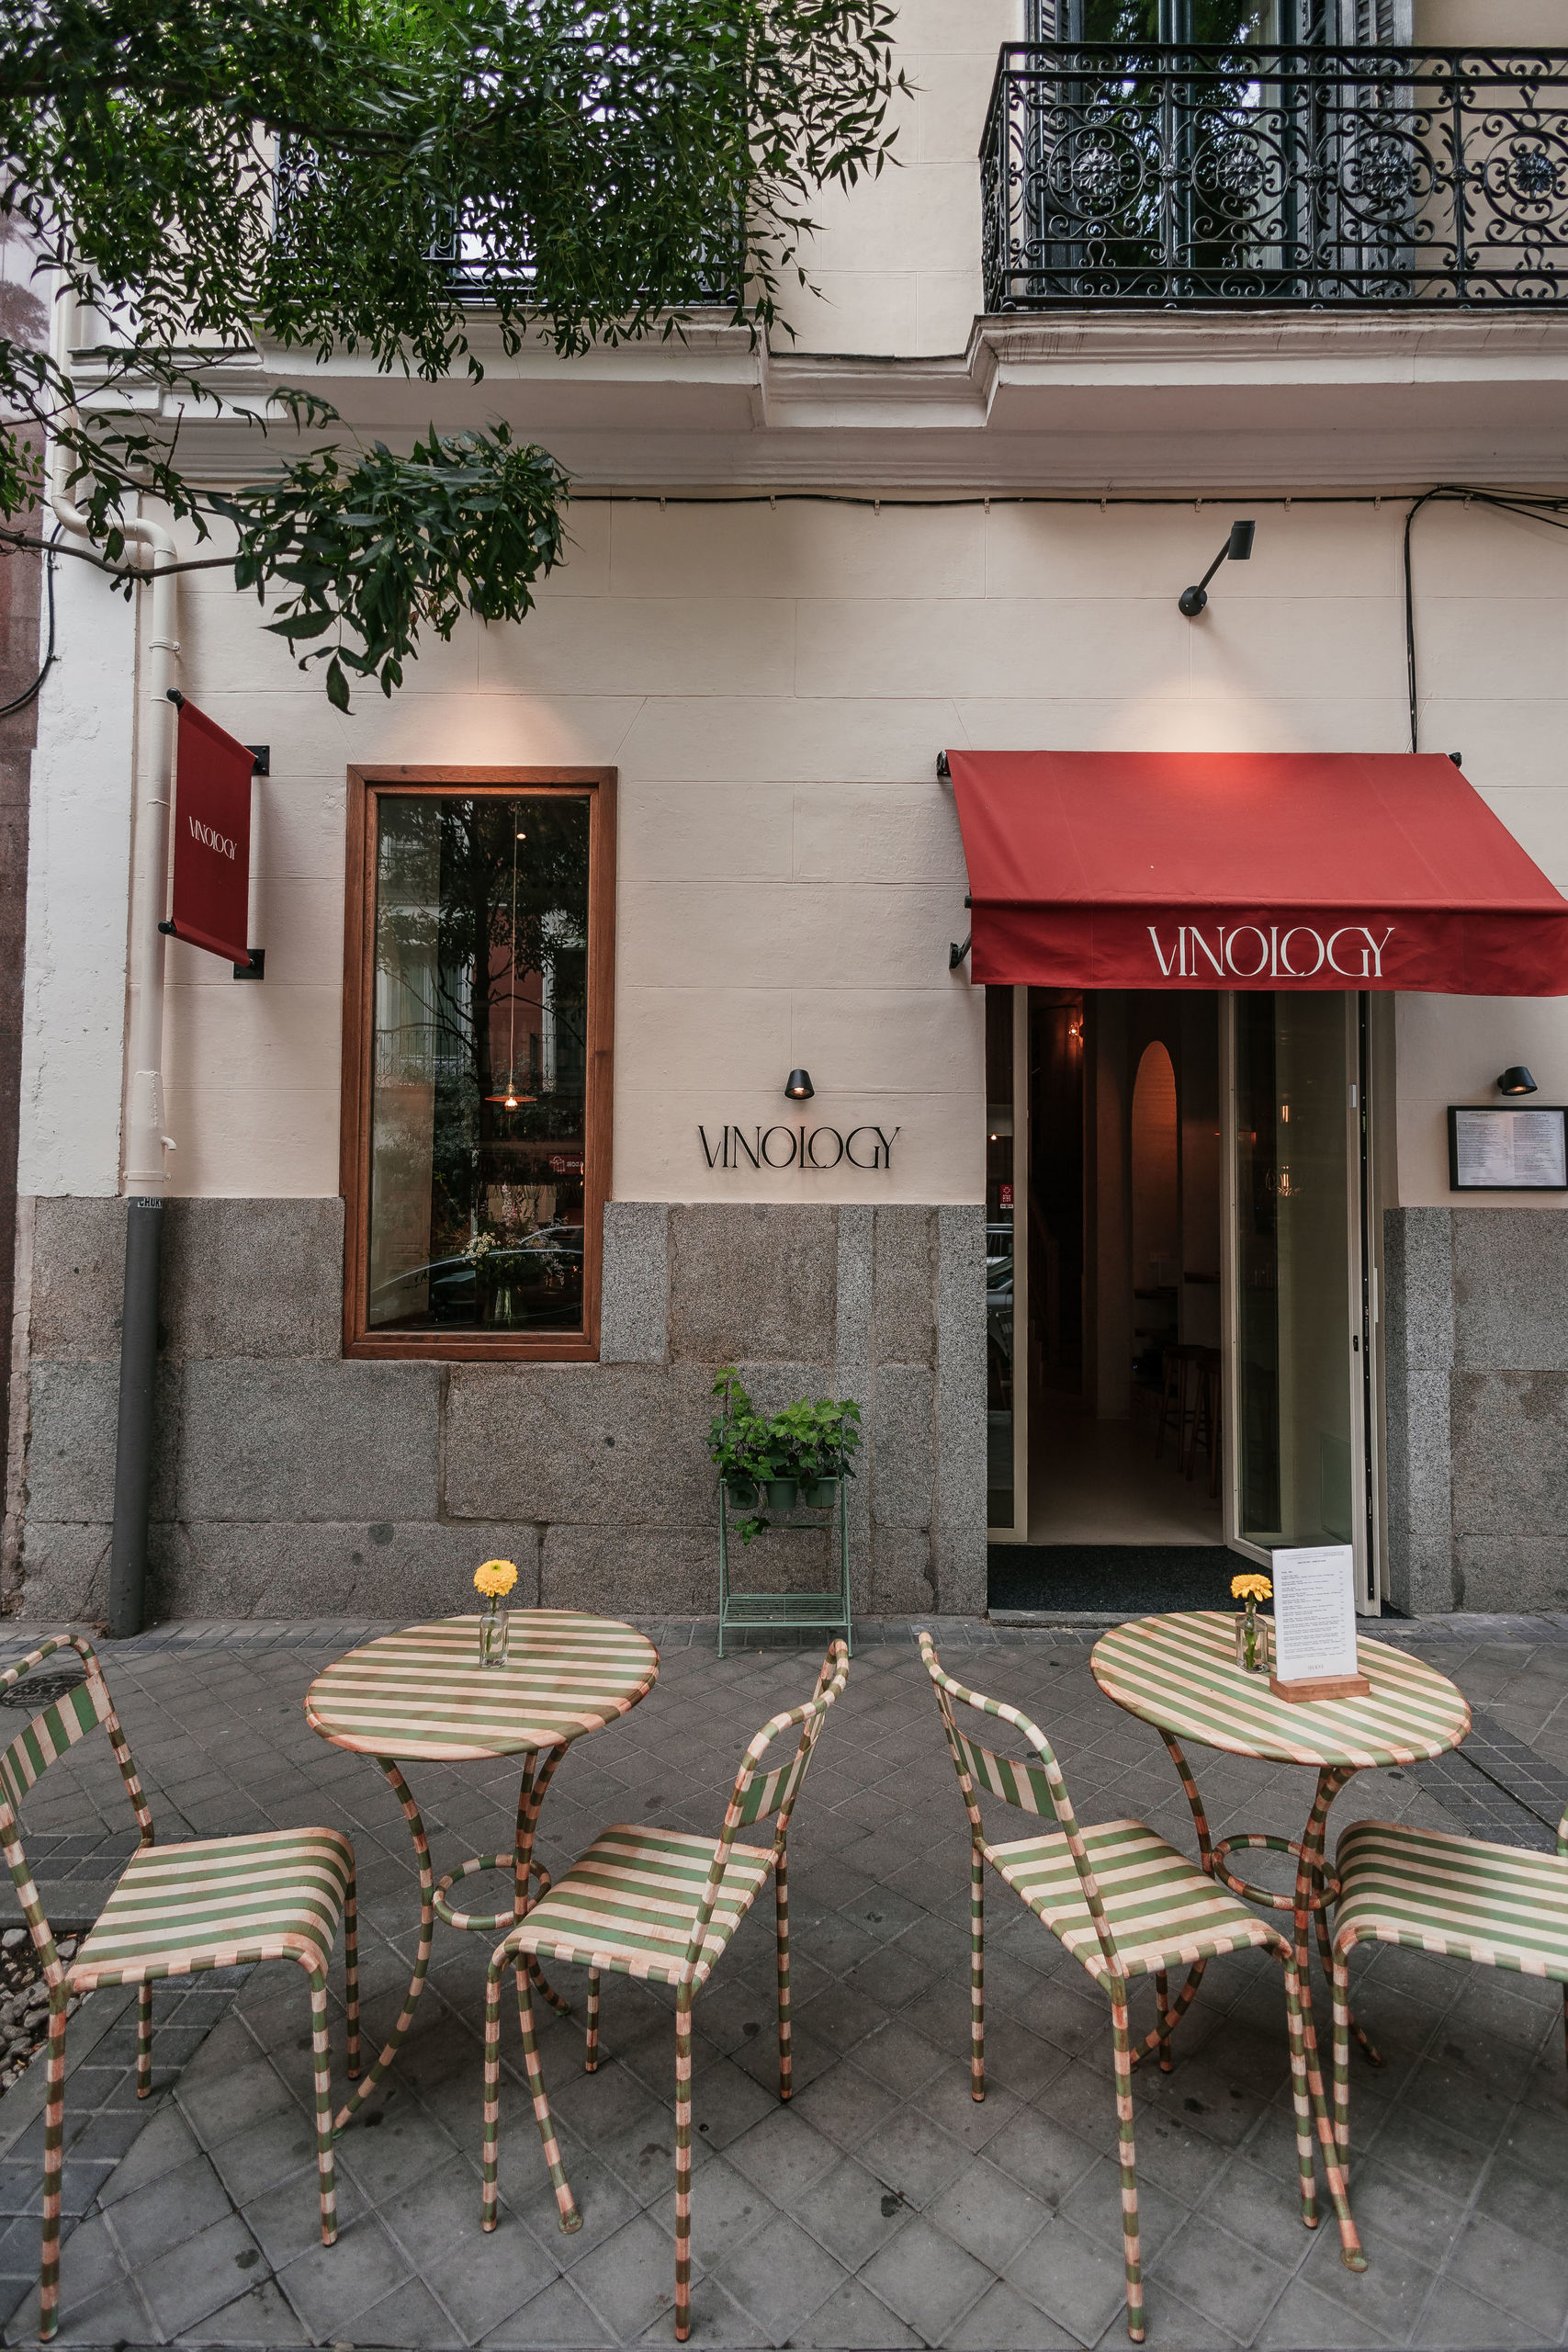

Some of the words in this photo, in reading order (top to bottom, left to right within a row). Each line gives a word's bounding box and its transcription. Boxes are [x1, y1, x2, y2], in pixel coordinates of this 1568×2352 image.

[188, 815, 238, 861] VINOLOGY
[1146, 925, 1396, 978] VINOLOGY
[697, 1125, 903, 1170] VINOLOGY
